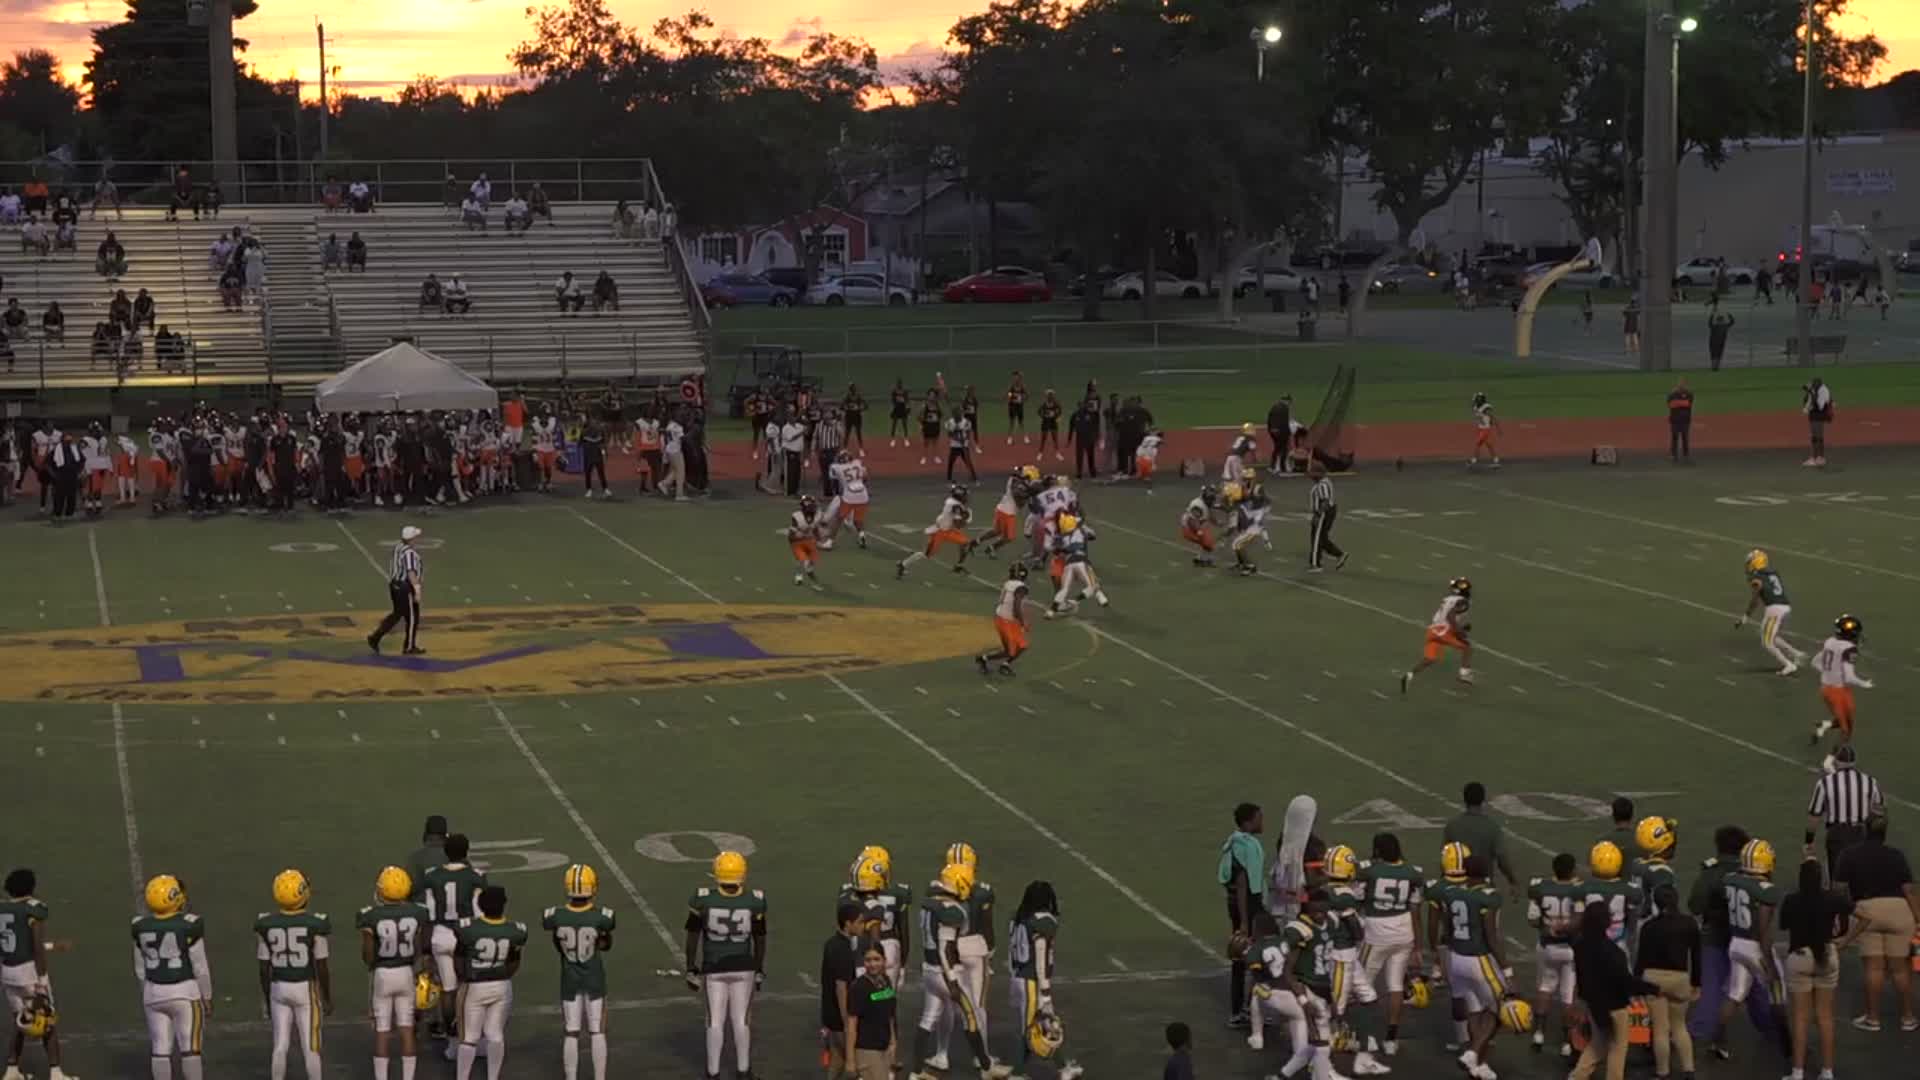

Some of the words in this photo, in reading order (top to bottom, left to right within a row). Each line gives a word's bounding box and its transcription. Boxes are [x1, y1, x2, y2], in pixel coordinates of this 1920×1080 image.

[1768, 575, 1783, 596] 3
[444, 882, 458, 921] 1
[1373, 878, 1410, 910] 51
[707, 908, 752, 943] 53
[1451, 899, 1471, 940] 2
[139, 931, 182, 969] 54
[267, 926, 309, 968] 25
